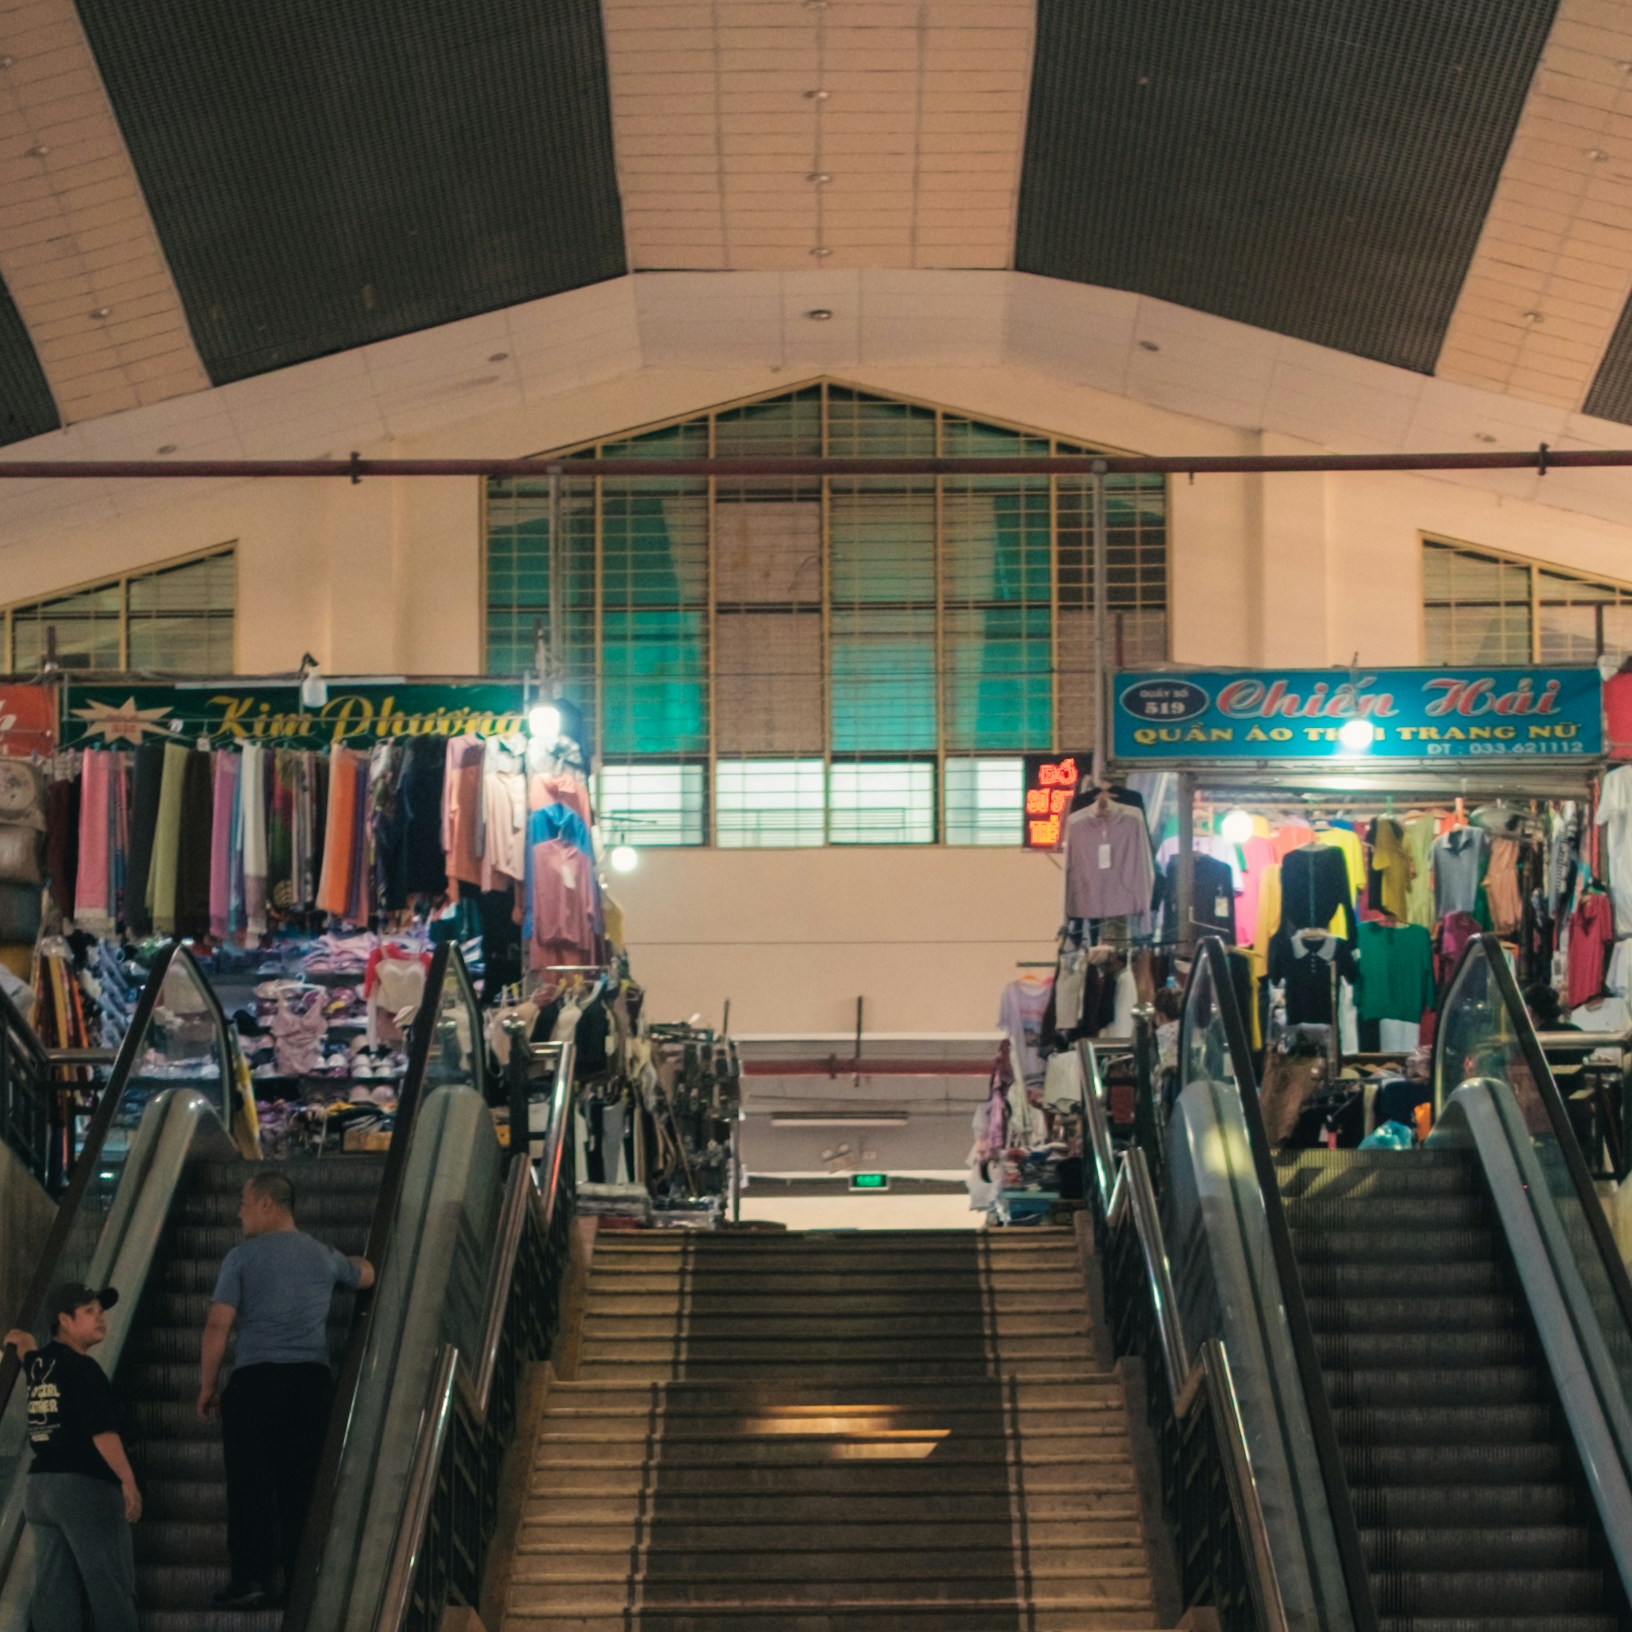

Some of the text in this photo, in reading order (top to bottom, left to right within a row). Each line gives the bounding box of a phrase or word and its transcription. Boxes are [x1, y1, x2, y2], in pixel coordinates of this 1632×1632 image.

[1145, 702, 1185, 714] 519
[1216, 674, 1398, 719] Chiến
[206, 696, 317, 738] Kim
[1398, 727, 1515, 742] TRANG
